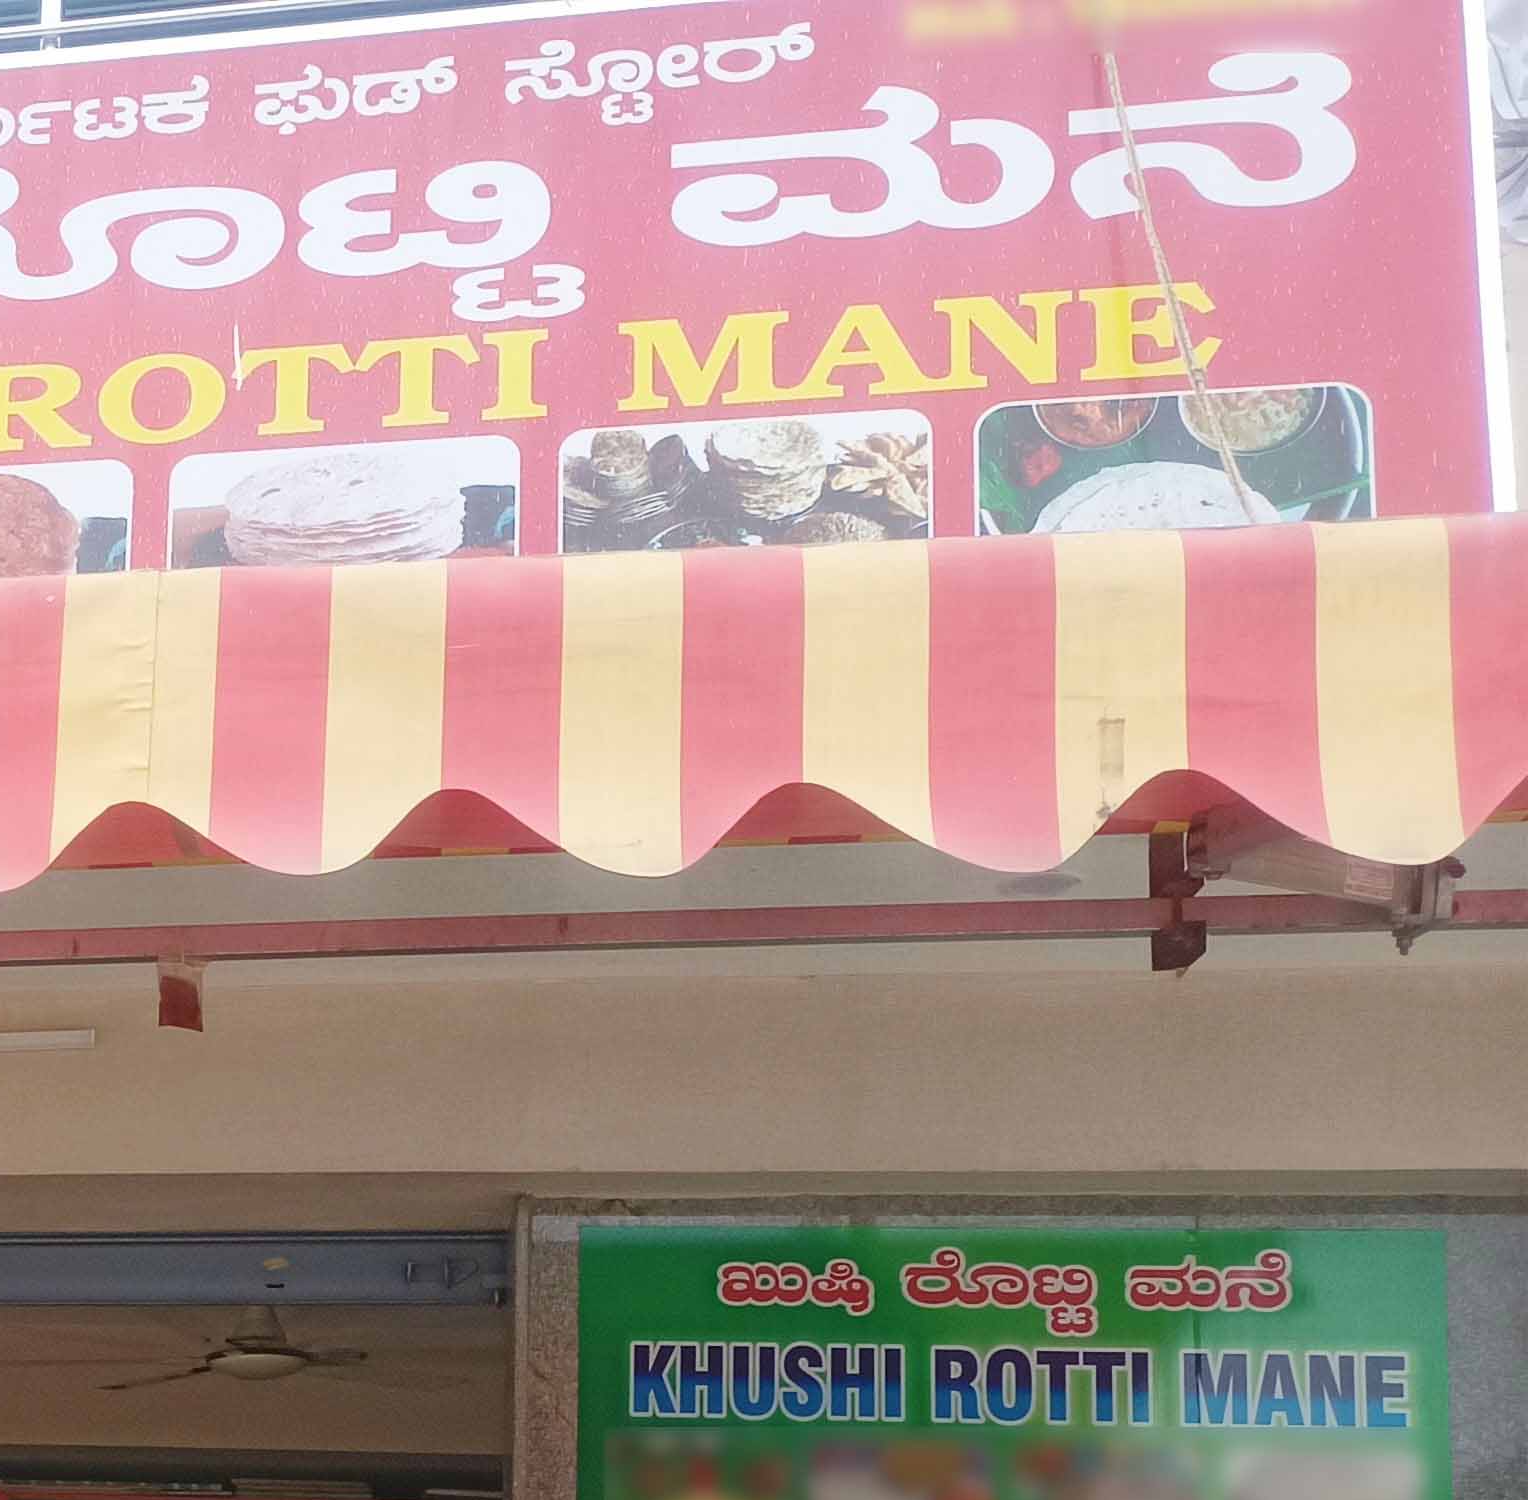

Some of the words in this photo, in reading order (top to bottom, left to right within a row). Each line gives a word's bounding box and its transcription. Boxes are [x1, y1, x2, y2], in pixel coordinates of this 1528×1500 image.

[669, 47, 1358, 247] ಮನೆ
[619, 281, 1221, 412] MANE
[718, 1258, 874, 1315] ಖುಷಿ
[1127, 1250, 1291, 1311] ಮನೆ
[631, 1343, 904, 1420] KHUSHI
[932, 1345, 1153, 1424] ROTTI
[1181, 1349, 1409, 1429] MANE
